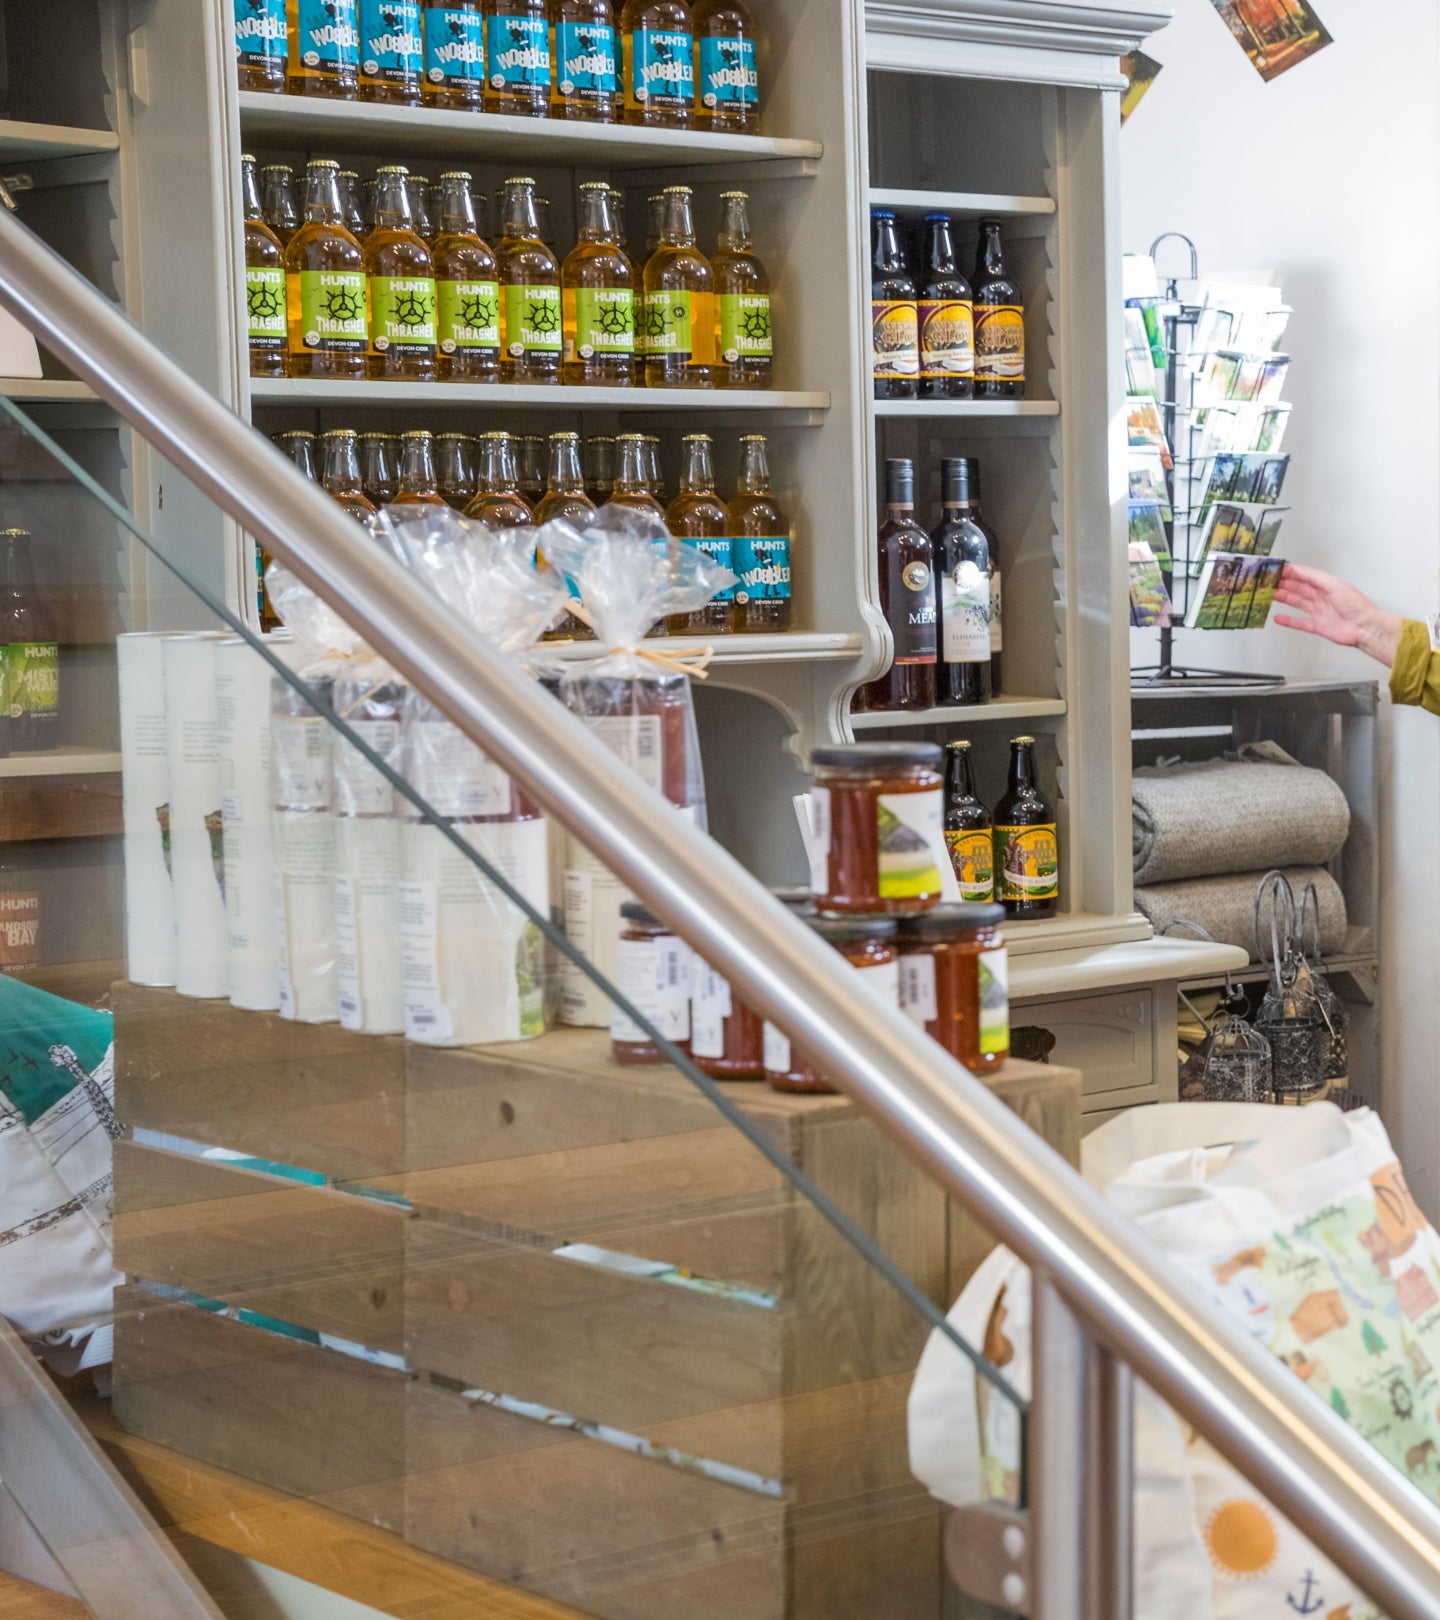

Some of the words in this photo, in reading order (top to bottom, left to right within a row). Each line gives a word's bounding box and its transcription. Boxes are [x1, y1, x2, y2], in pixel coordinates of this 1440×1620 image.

[379, 4, 417, 19] HUNTS
[445, 13, 480, 27] HUNTS
[505, 19, 543, 34] HUNTS
[574, 26, 610, 40] HUNTS
[650, 34, 687, 47] HUNTS
[717, 41, 752, 53] HUNTS
[246, 271, 281, 283] HUNTS
[320, 275, 361, 287] HUNTS
[389, 281, 429, 292] HUNTS
[456, 284, 494, 296] HUNTS
[525, 289, 558, 300] HUNTS
[594, 291, 630, 303] HUNTS
[739, 298, 769, 308] HUNTS
[696, 541, 730, 551] HUNTS
[751, 541, 785, 551] HUNTS
[24, 646, 59, 658] HUNTS
[0, 897, 38, 911] HUNTS
[7, 928, 37, 946] BAY
